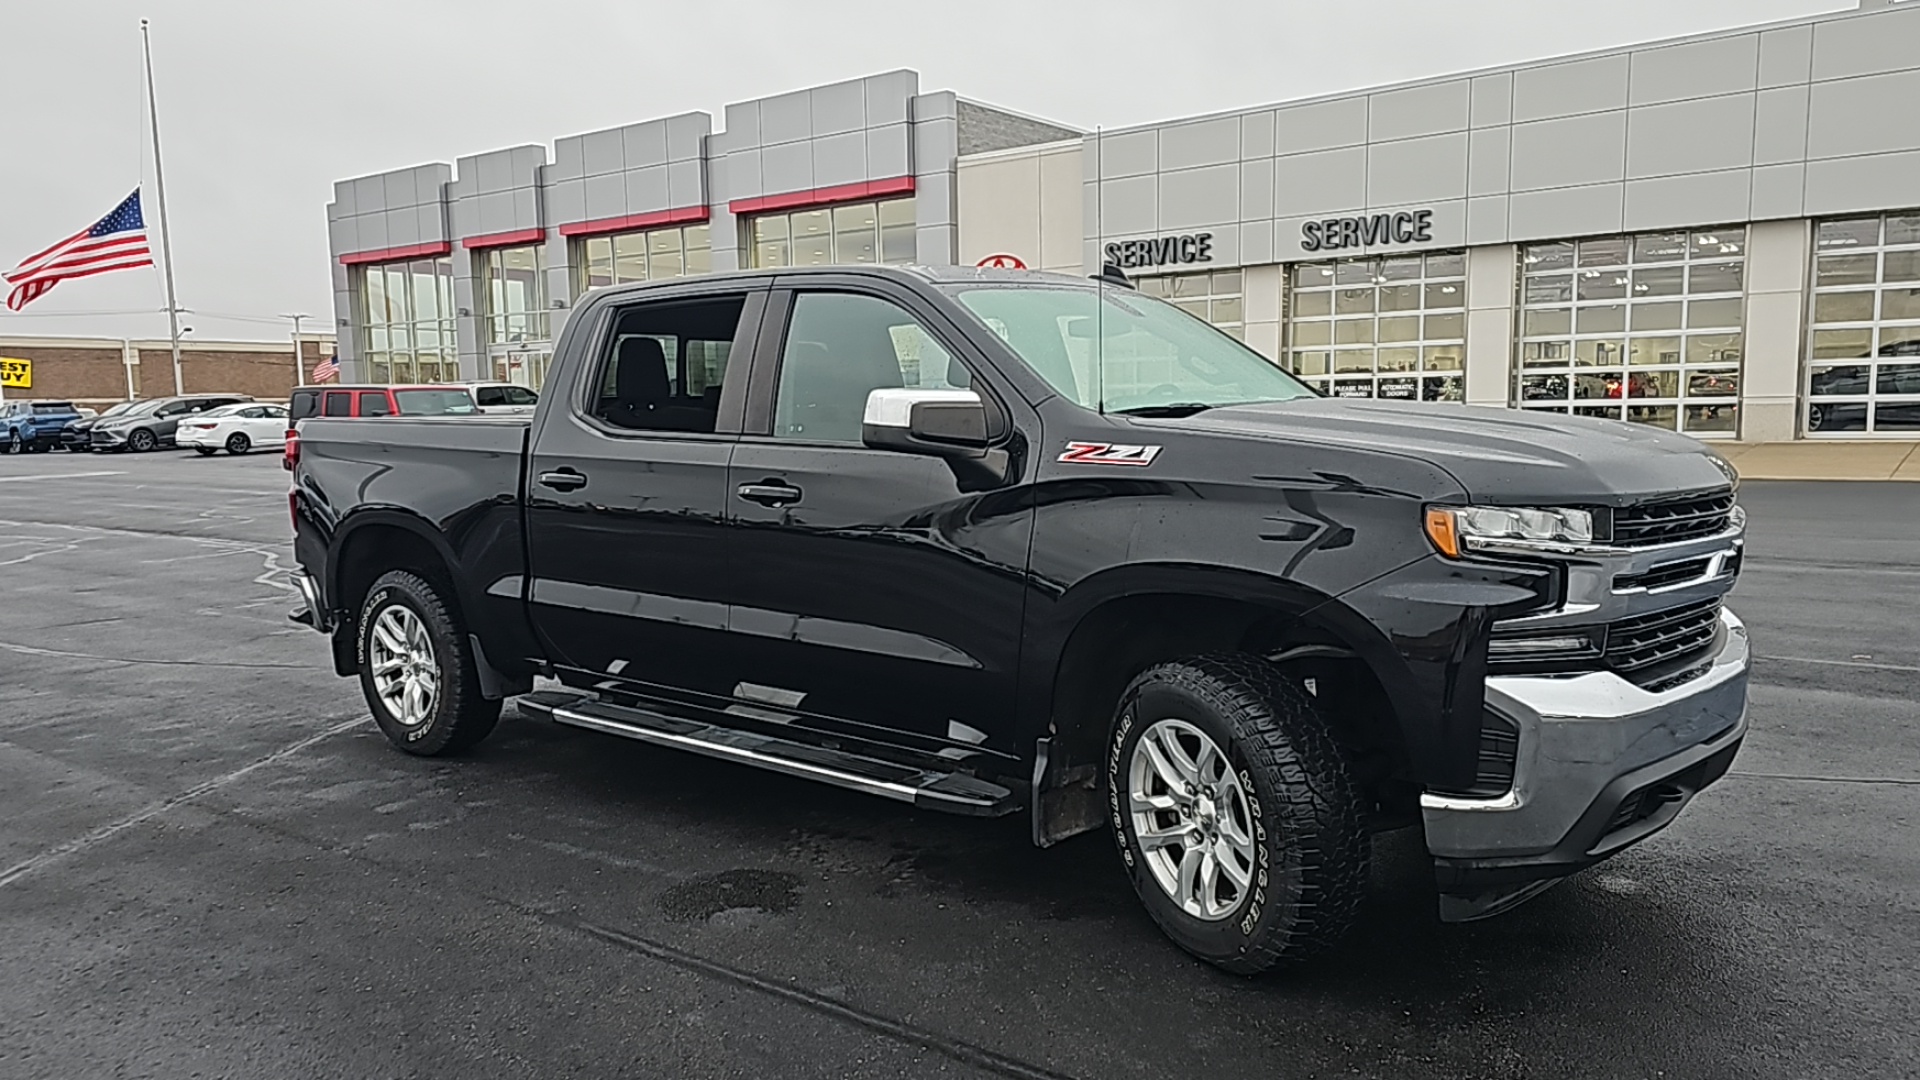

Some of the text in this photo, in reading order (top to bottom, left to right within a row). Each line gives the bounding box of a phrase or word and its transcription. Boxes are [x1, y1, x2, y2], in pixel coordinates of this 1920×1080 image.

[1103, 232, 1214, 269] SERVICE
[1301, 209, 1433, 252] SERVICE
[1107, 714, 1134, 867] GOODYEAR
[1240, 770, 1269, 935] WRANGLER
